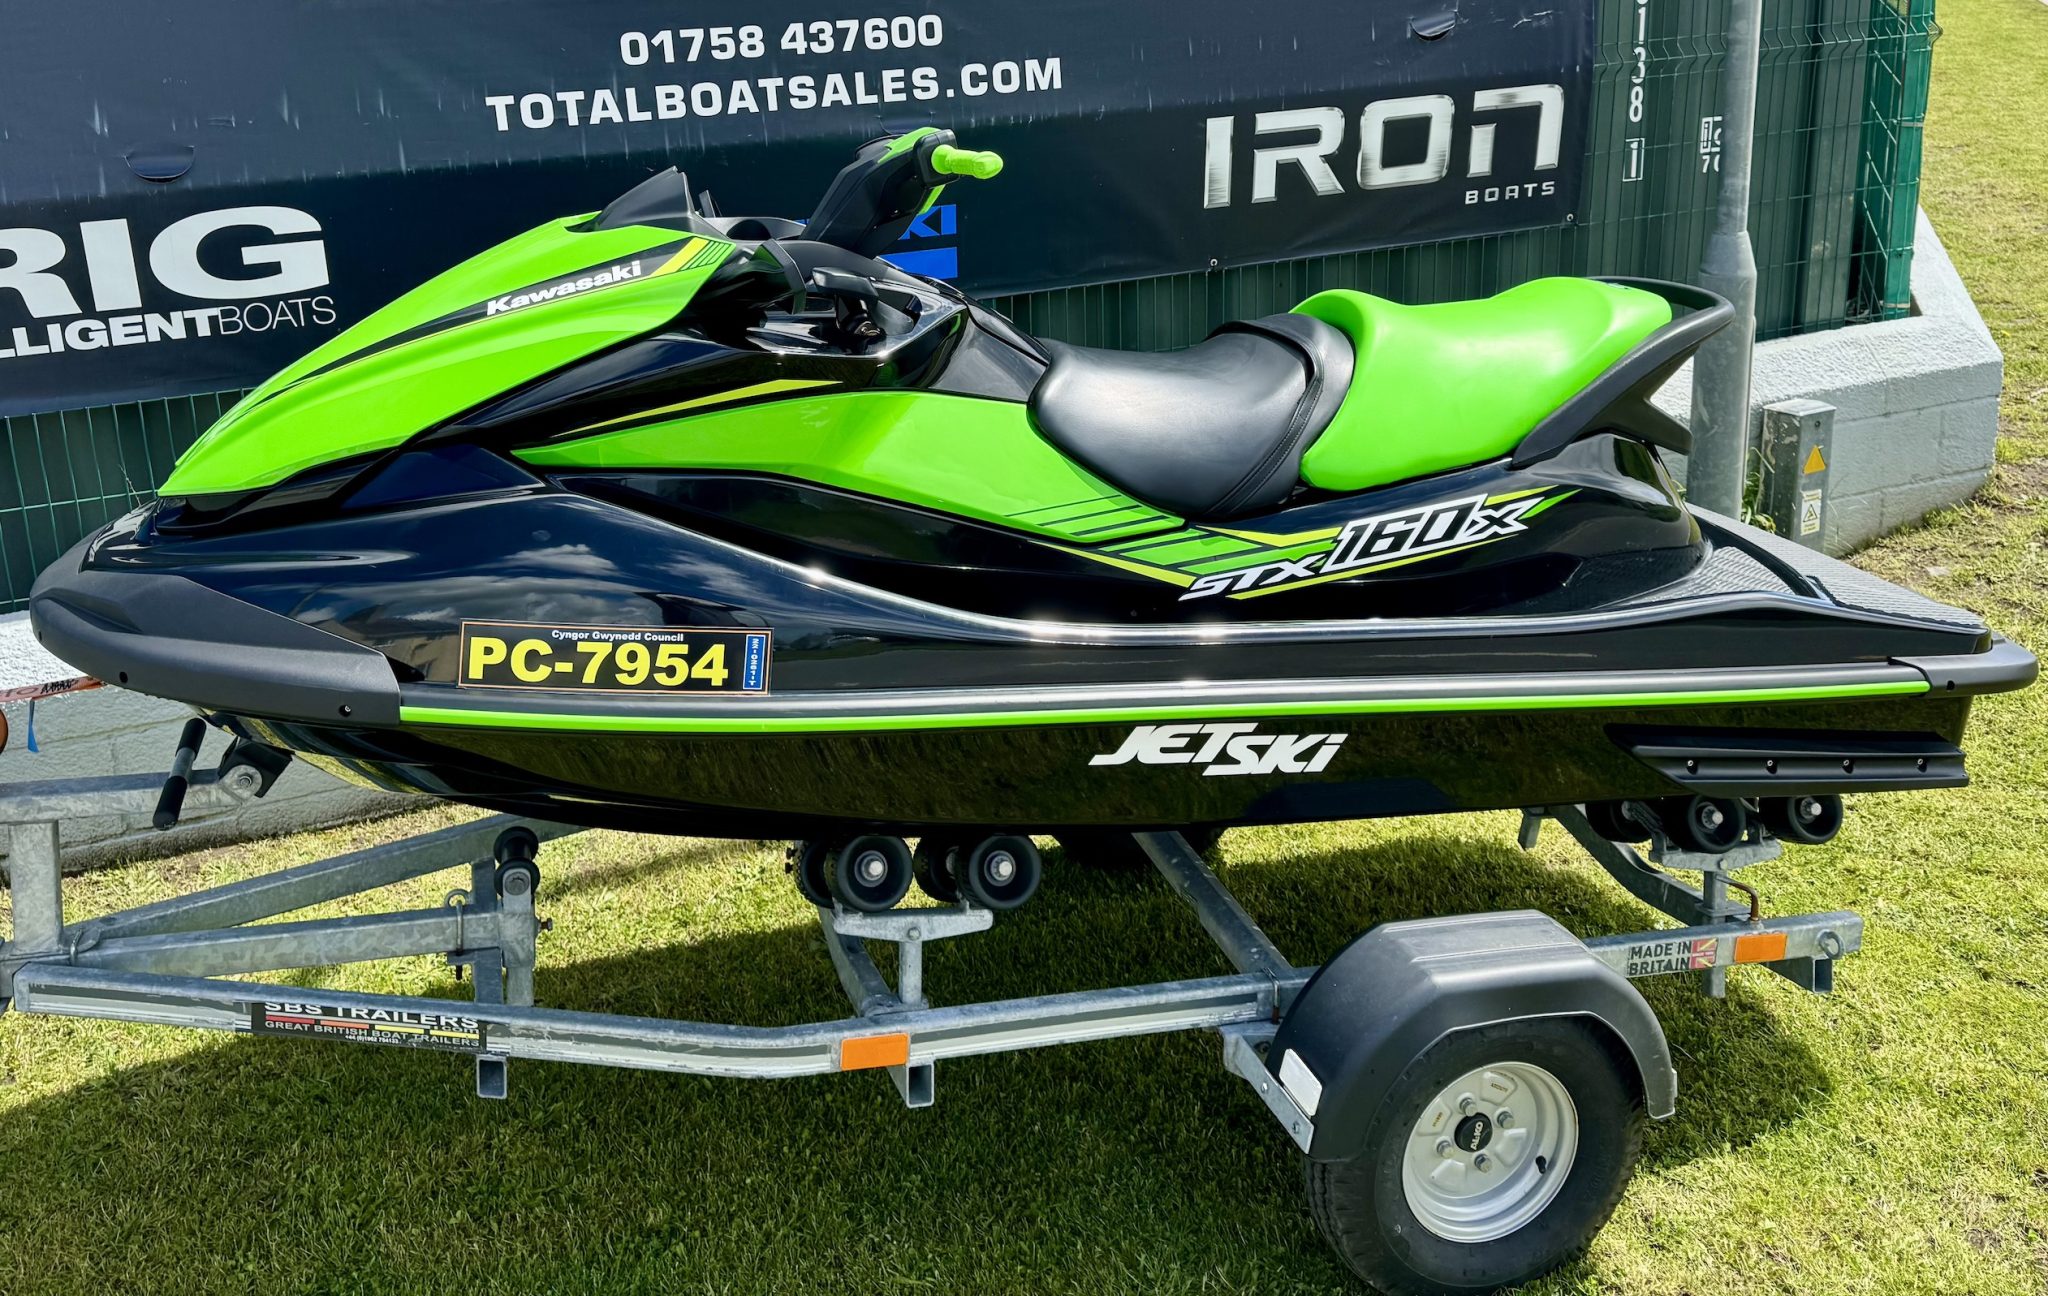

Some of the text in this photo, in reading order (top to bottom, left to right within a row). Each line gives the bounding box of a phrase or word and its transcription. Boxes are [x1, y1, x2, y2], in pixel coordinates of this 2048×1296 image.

[619, 14, 944, 67] 01758 437600
[1629, 0, 1649, 123] 138
[486, 57, 1063, 132] TOTALBOATSALES.COM
[1203, 83, 1565, 209] IRON
[1465, 181, 1555, 205] BOATS
[486, 260, 641, 316] Kawasaki
[0, 295, 338, 359] LIGENTBOATS
[551, 629, 684, 642] Cyngor Gwynedd Council
[468, 636, 729, 687] PC-7954
[1628, 957, 1691, 977] BRITAIN
[1630, 941, 1692, 960] MADE IN
[264, 1001, 479, 1029] SBS TRAILERS
[265, 1020, 480, 1047] GREAT BRITISH BOAT TRAILERS
